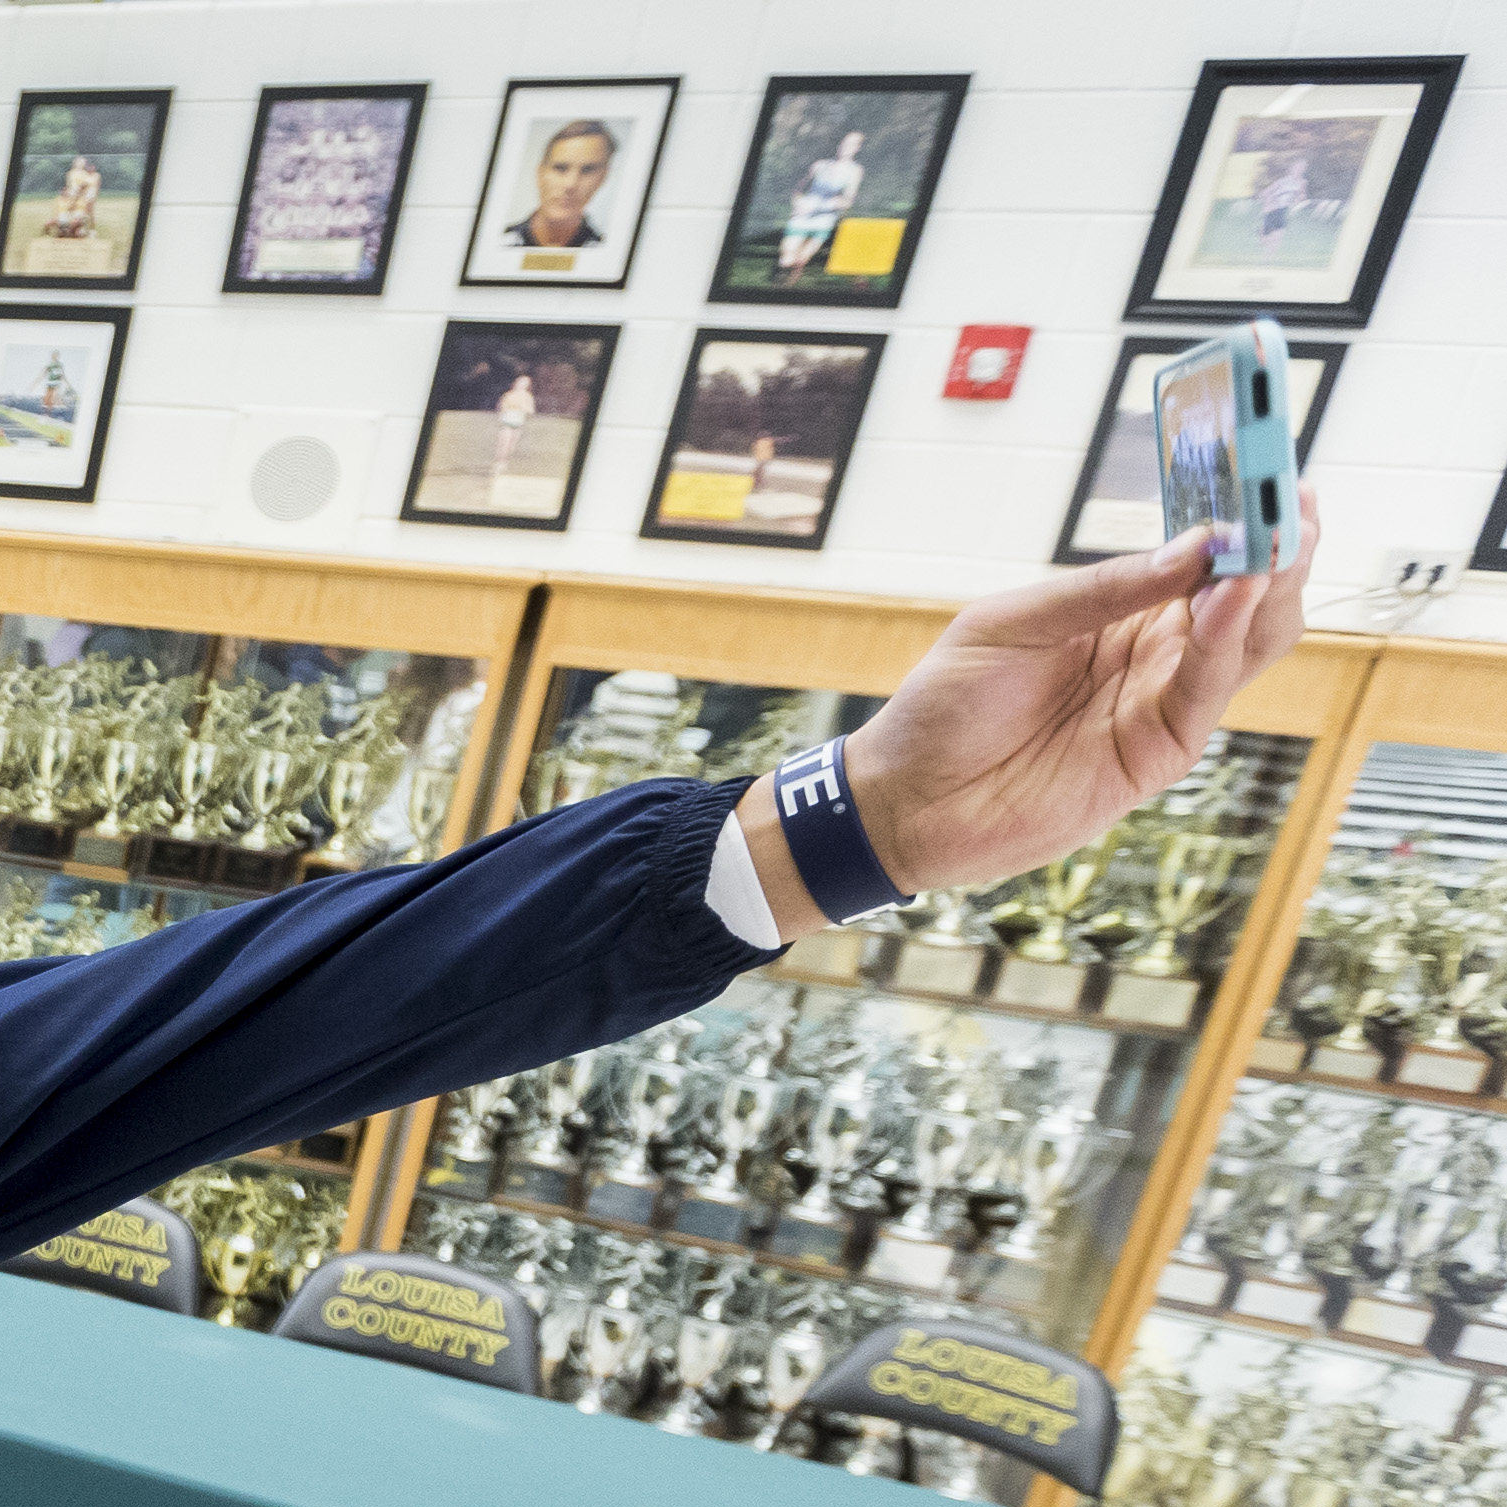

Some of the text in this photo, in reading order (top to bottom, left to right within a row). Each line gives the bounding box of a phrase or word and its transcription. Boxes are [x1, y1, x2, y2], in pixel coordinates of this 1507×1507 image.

[28, 1235, 172, 1288] OUNTY
[339, 1262, 508, 1331] LOUISA
[321, 1298, 512, 1366] COUNTY
[869, 1361, 1079, 1446] COUNTY
[893, 1328, 1078, 1410] LOUISA
